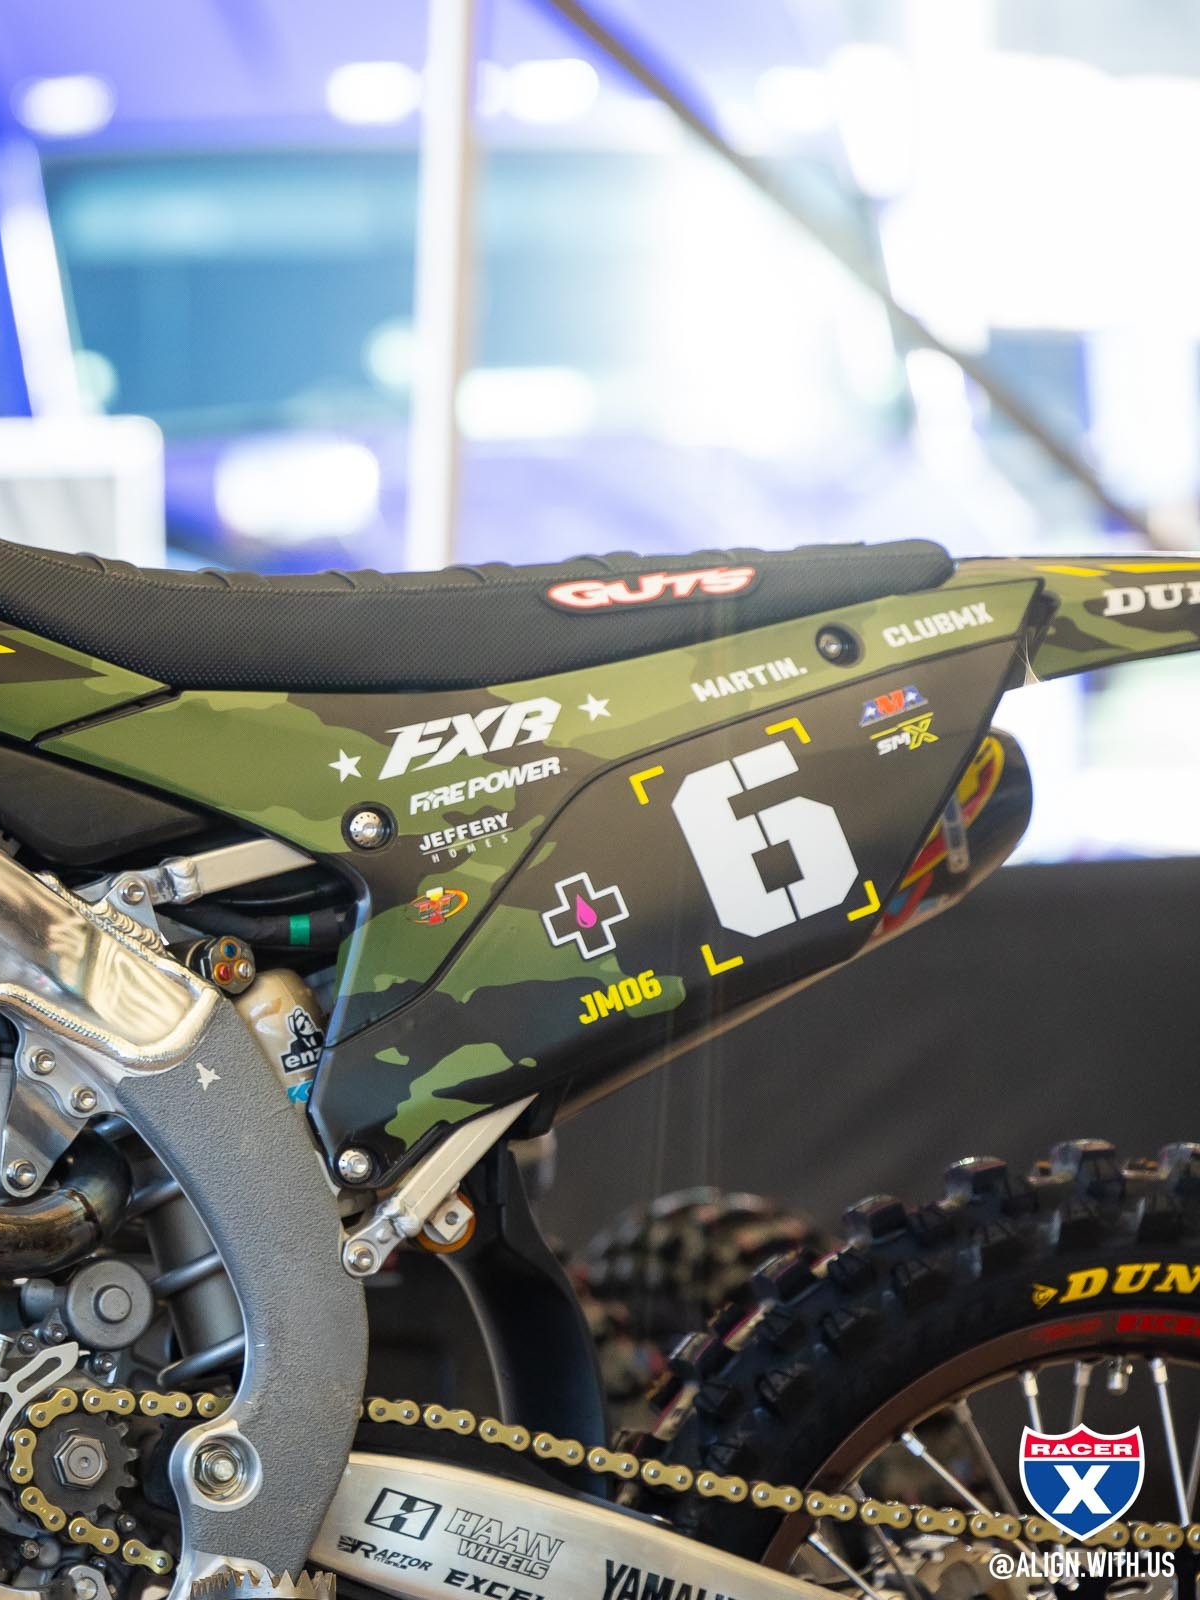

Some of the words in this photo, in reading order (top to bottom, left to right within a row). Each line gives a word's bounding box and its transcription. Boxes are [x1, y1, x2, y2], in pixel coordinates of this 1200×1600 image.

[547, 567, 755, 608] GUTS
[1103, 581, 1200, 617] DU
[882, 603, 993, 648] CLUBMX
[690, 658, 808, 702] MARTIN.
[378, 697, 562, 780] FXR
[876, 717, 940, 756] SMX
[419, 812, 509, 851] JEFFERY
[431, 834, 509, 863] HOMES
[671, 740, 859, 938] 6
[578, 970, 662, 1026] JM06
[351, 1538, 433, 1571] RAPTOR
[444, 1507, 565, 1564] HAAN
[456, 1538, 553, 1580] WHEELS
[443, 1568, 548, 1600] EXCE
